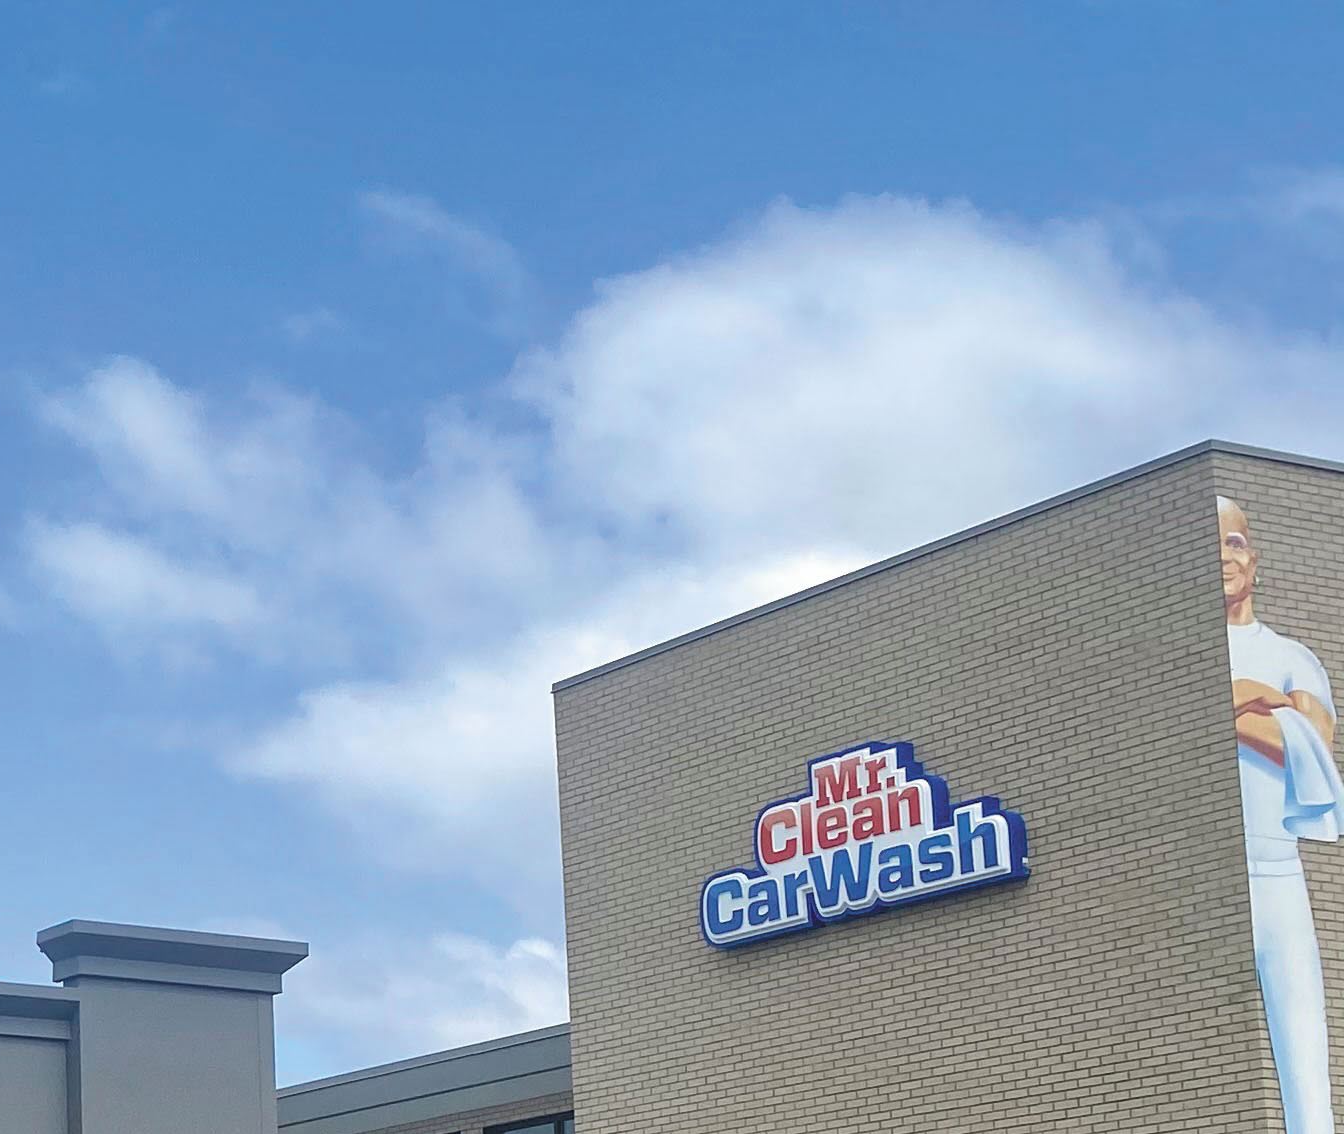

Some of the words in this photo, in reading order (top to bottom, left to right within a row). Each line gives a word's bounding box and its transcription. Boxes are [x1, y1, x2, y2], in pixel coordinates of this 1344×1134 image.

[814, 756, 896, 808] Mr.
[760, 785, 922, 865] Clean
[706, 809, 999, 934] CarWash
